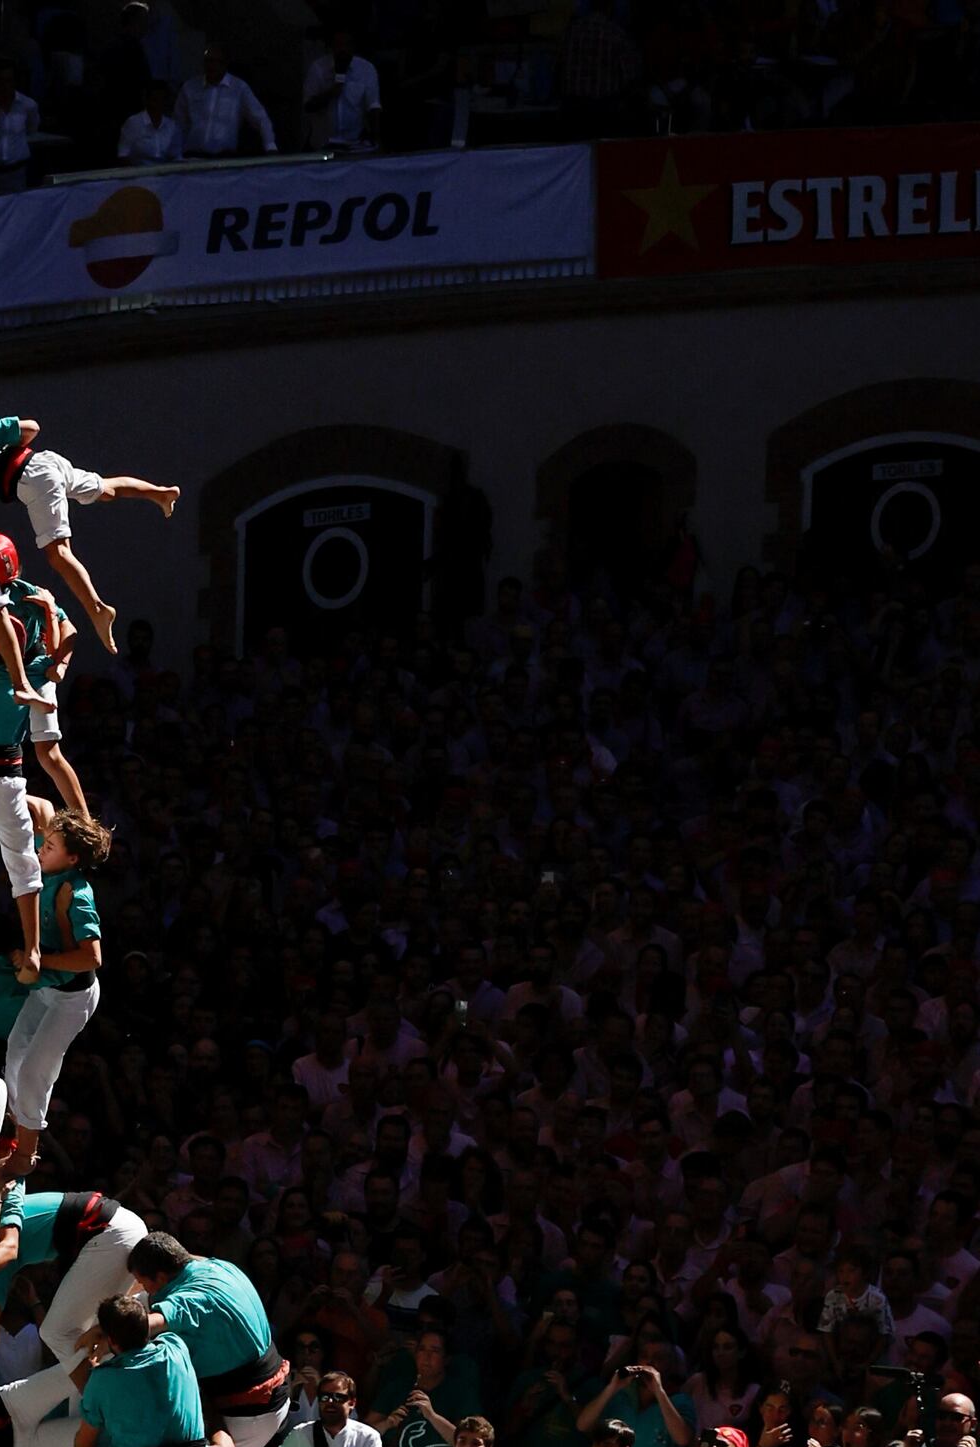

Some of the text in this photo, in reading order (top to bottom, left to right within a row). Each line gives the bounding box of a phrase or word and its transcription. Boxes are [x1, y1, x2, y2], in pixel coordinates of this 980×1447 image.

[207, 192, 439, 253] REPSOL
[730, 169, 980, 245] ESTREL
[310, 506, 365, 523] TORILES
